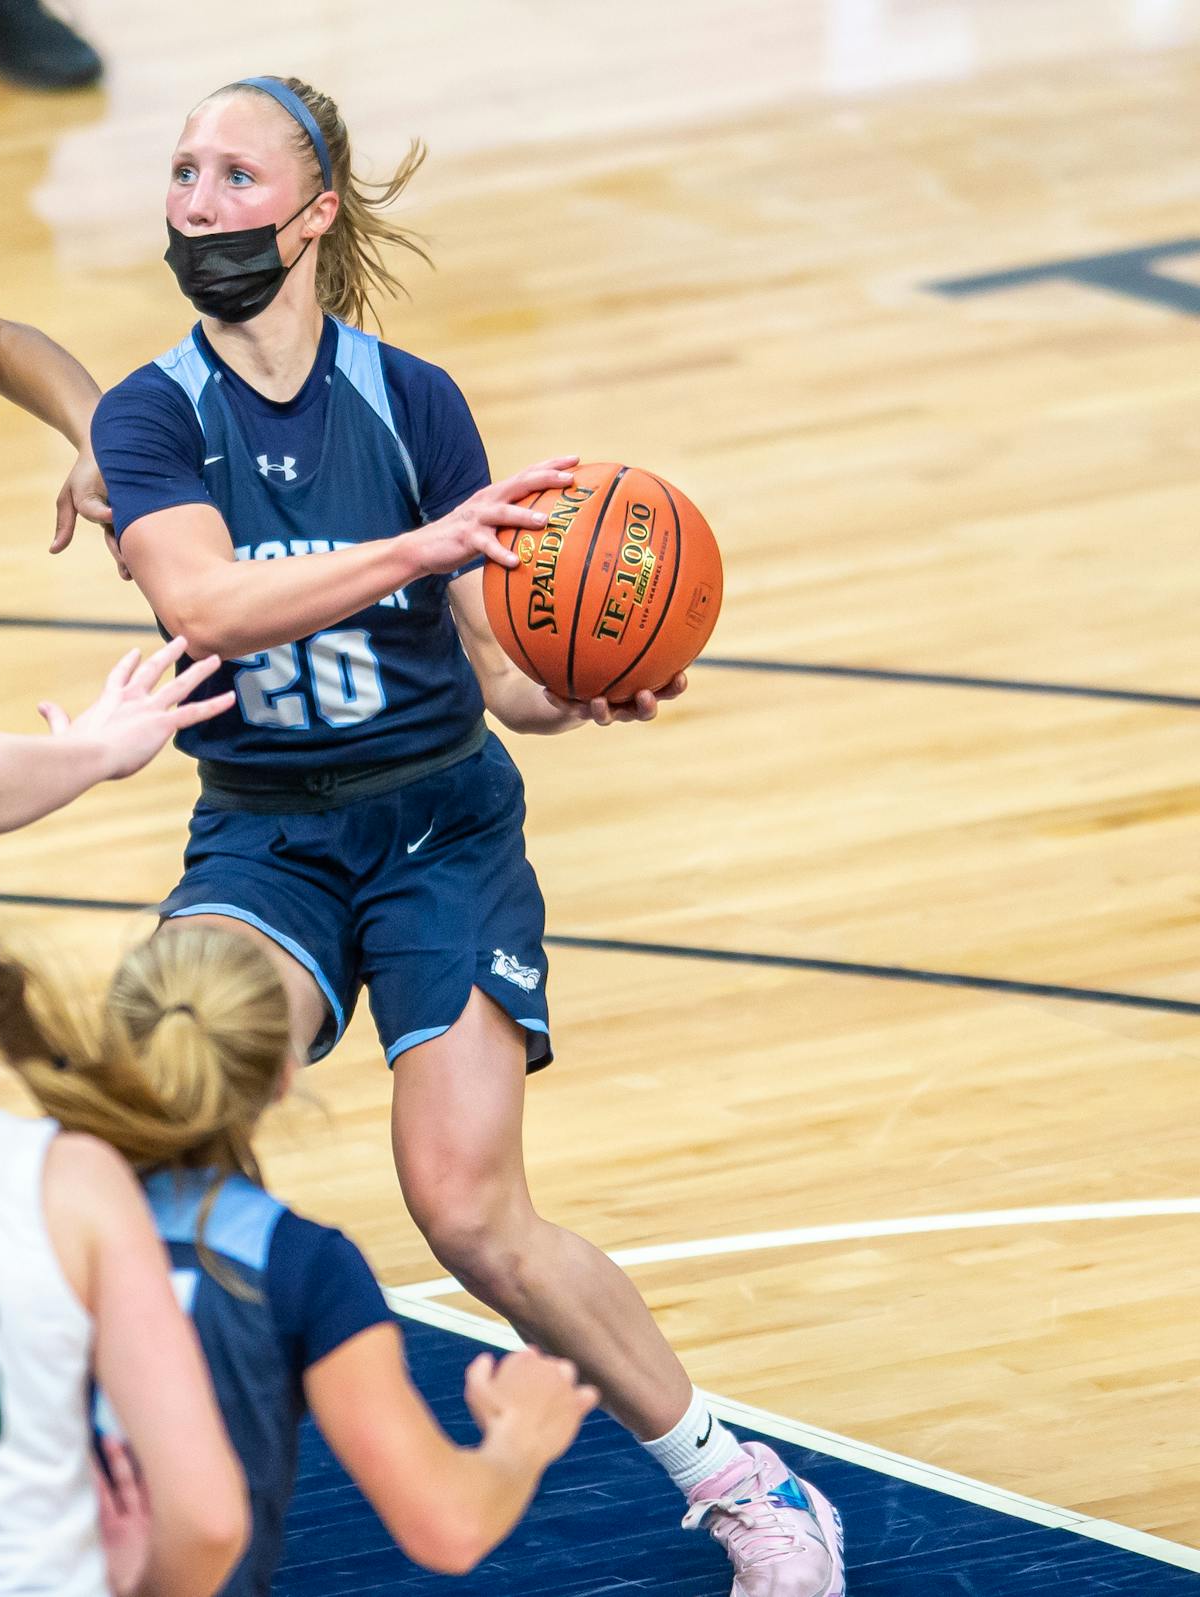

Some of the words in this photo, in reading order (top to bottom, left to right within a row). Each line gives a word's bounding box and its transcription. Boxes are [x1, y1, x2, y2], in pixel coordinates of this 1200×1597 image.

[527, 486, 595, 635] SPALDING
[597, 502, 651, 640] TF-1000
[633, 549, 656, 606] LEGACY
[231, 627, 388, 731] 20
